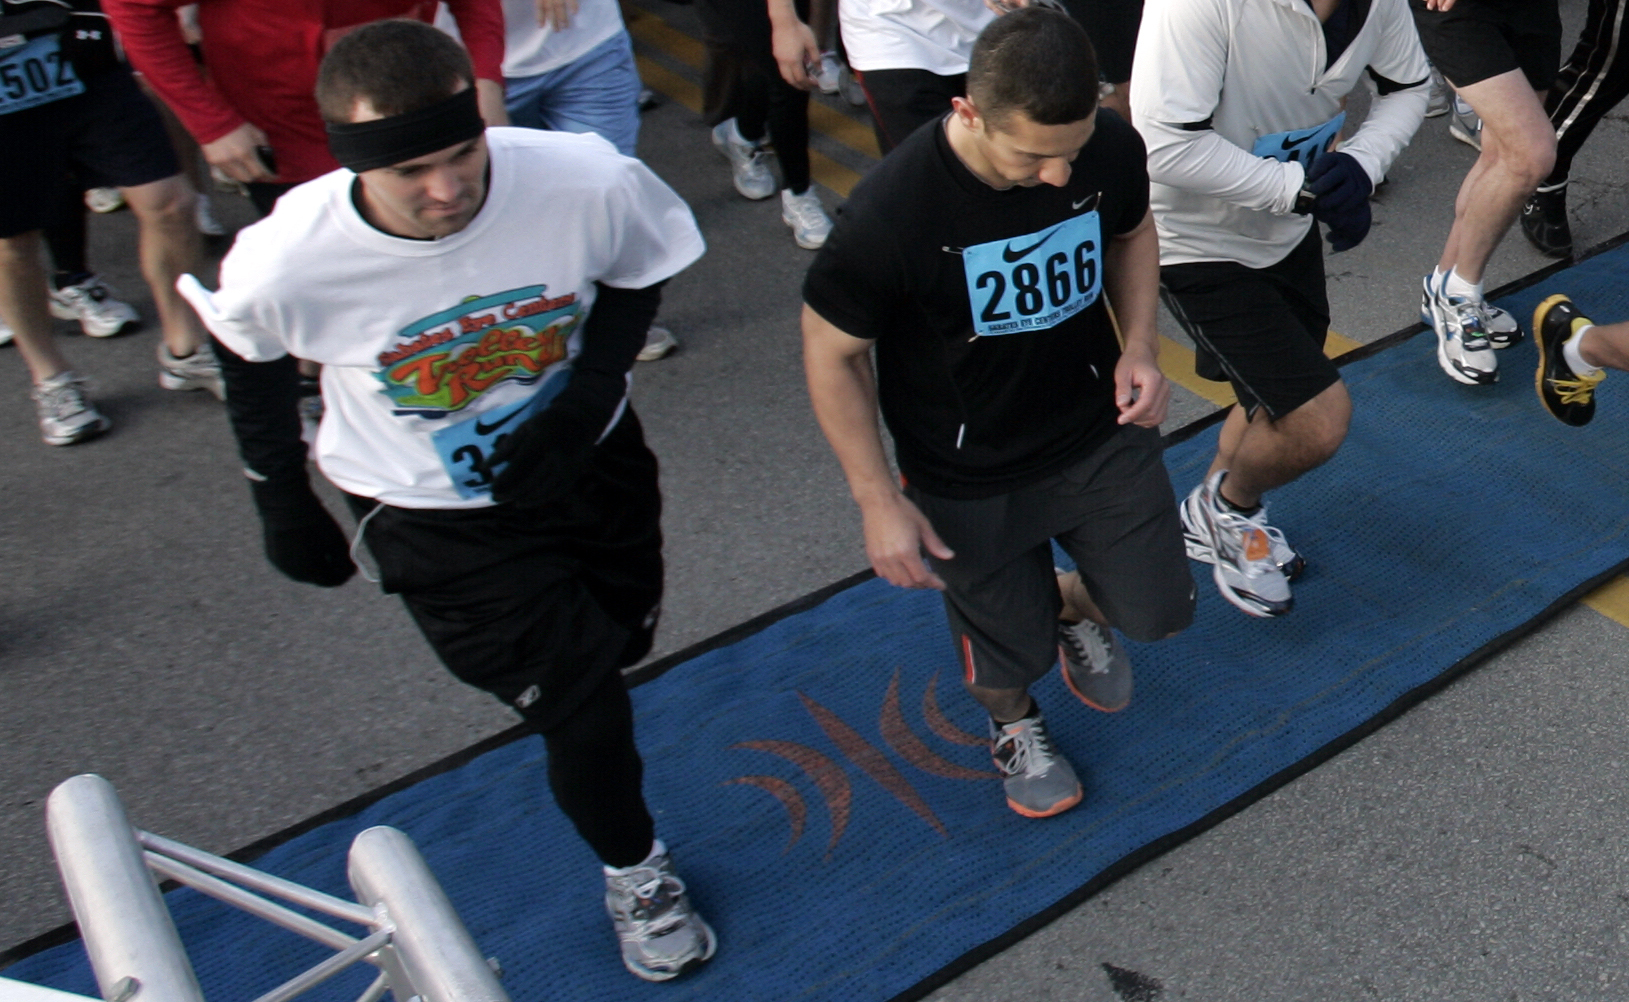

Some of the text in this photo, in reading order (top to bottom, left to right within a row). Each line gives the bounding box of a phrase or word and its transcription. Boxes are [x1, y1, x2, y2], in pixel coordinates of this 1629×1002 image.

[0, 51, 78, 104] 502
[976, 240, 1096, 323] 2866
[457, 313, 496, 334] Eye
[503, 292, 576, 320] Centers
[388, 315, 582, 395] Trolley
[448, 352, 542, 406] Run
